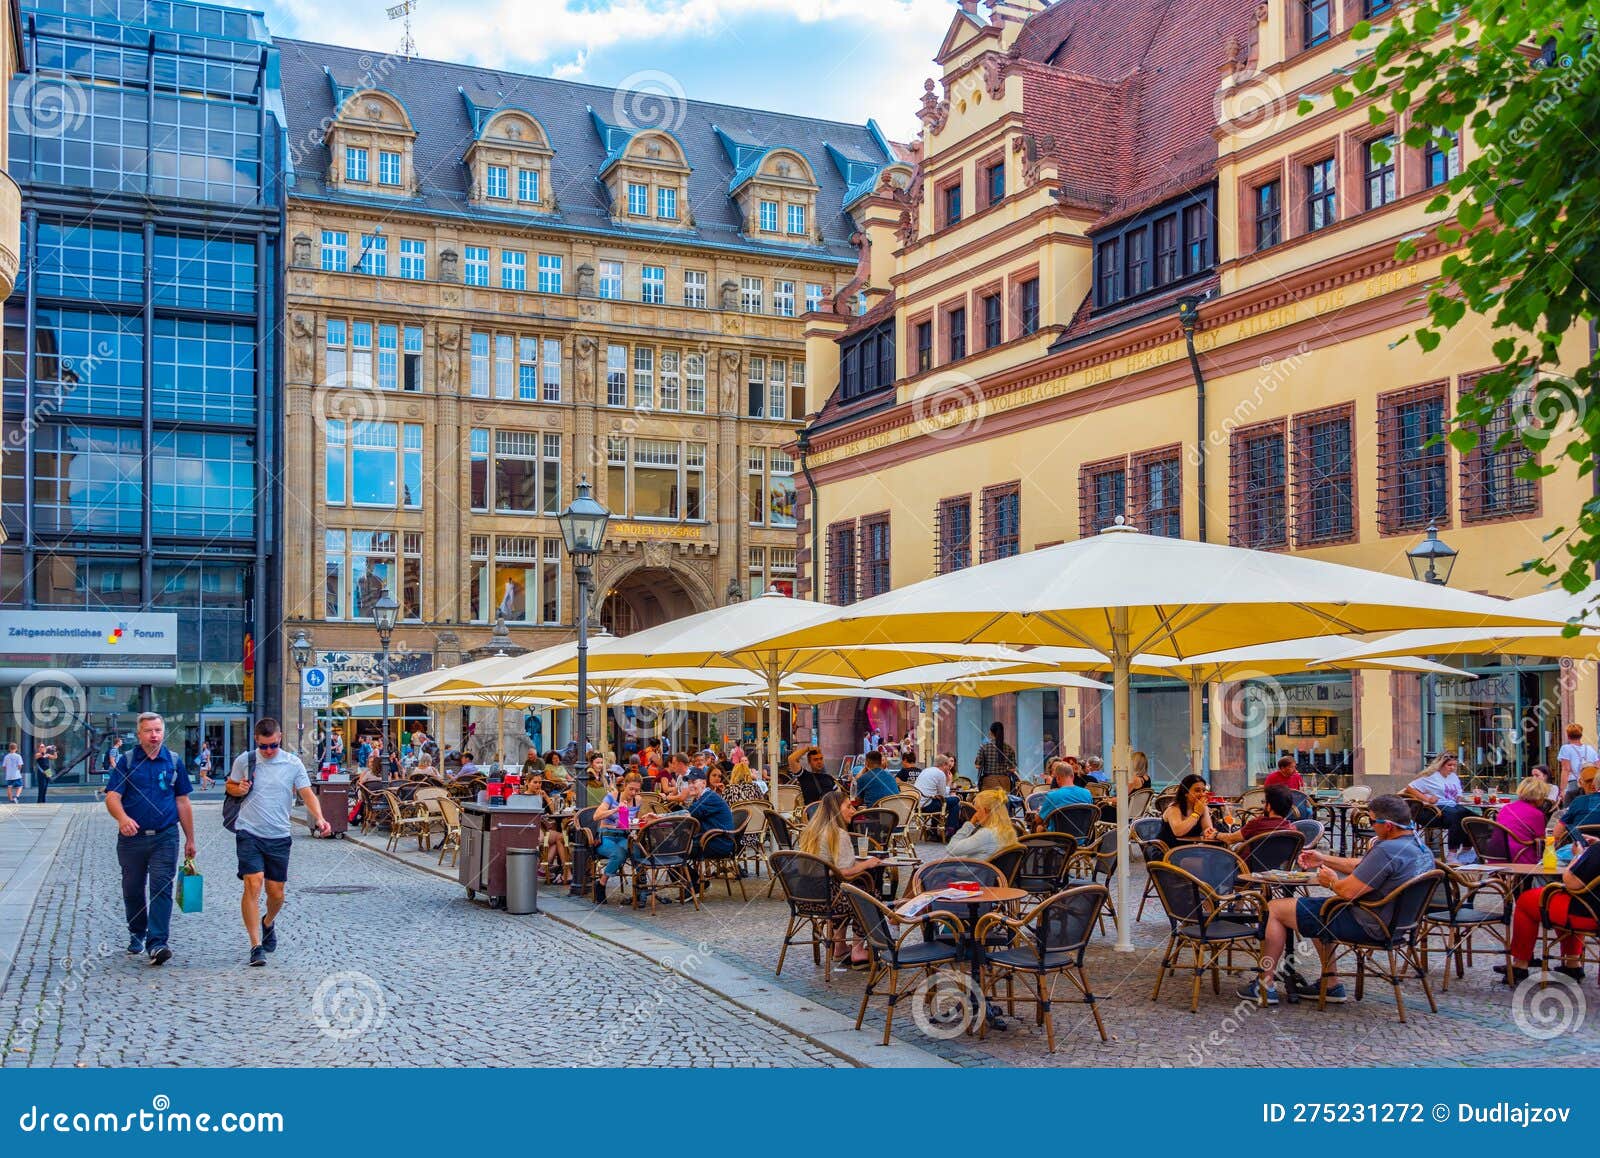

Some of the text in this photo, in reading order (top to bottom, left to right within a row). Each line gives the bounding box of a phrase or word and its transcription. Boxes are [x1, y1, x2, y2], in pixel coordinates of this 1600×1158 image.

[867, 432, 890, 450] ENDE
[1084, 364, 1112, 386] DEM
[1237, 305, 1297, 338] ALLEIN
[1315, 289, 1344, 314] DIE
[659, 526, 702, 538] PASSAGE
[8, 627, 164, 638] Zeitgeschichtliches Forum
